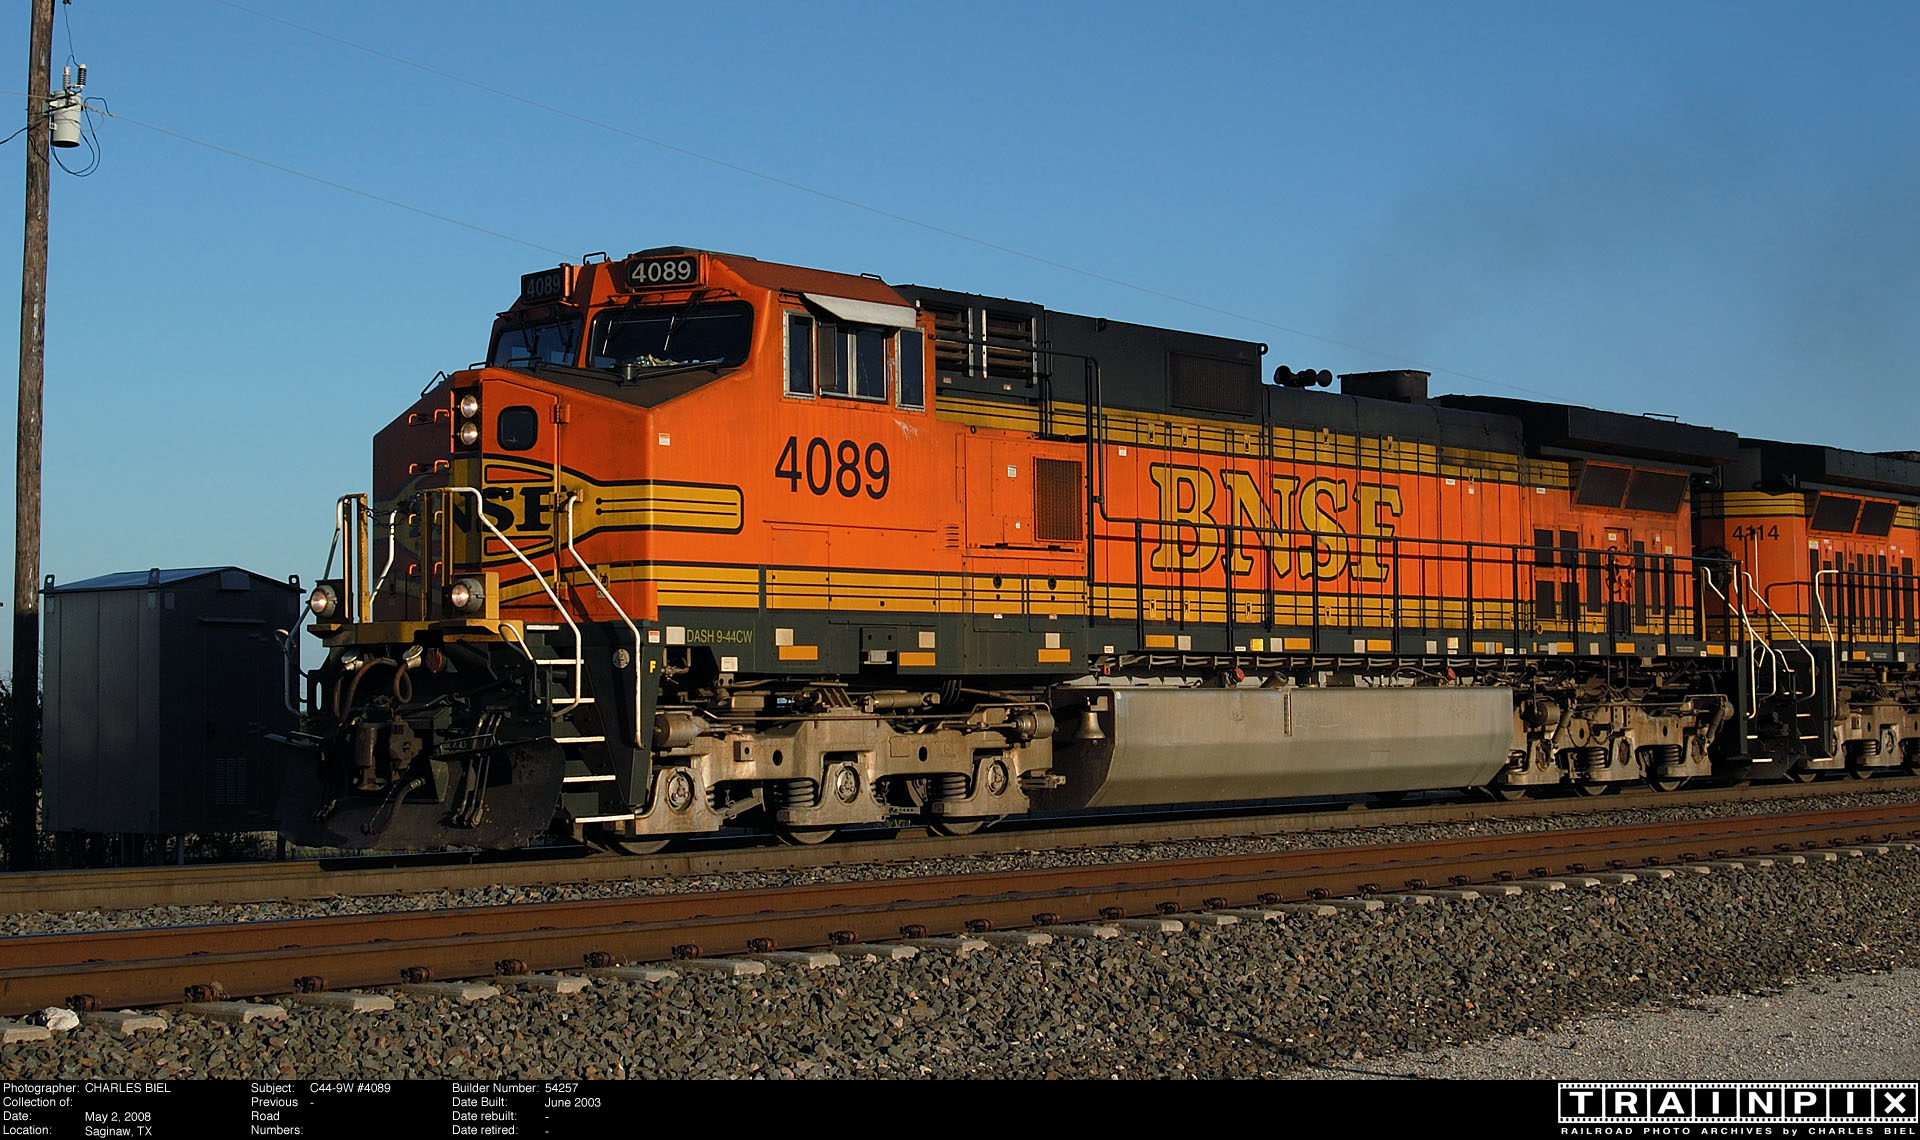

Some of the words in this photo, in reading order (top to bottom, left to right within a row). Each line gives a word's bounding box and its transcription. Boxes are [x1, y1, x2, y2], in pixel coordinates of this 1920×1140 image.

[631, 260, 692, 283] 4089
[526, 273, 561, 297] 4089
[774, 436, 890, 500] 4089
[1150, 462, 1403, 583] BNSF
[1732, 524, 1780, 541] 4114
[686, 629, 714, 643] DASH
[716, 629, 753, 643] 9-44CW
[648, 659, 657, 673] F
